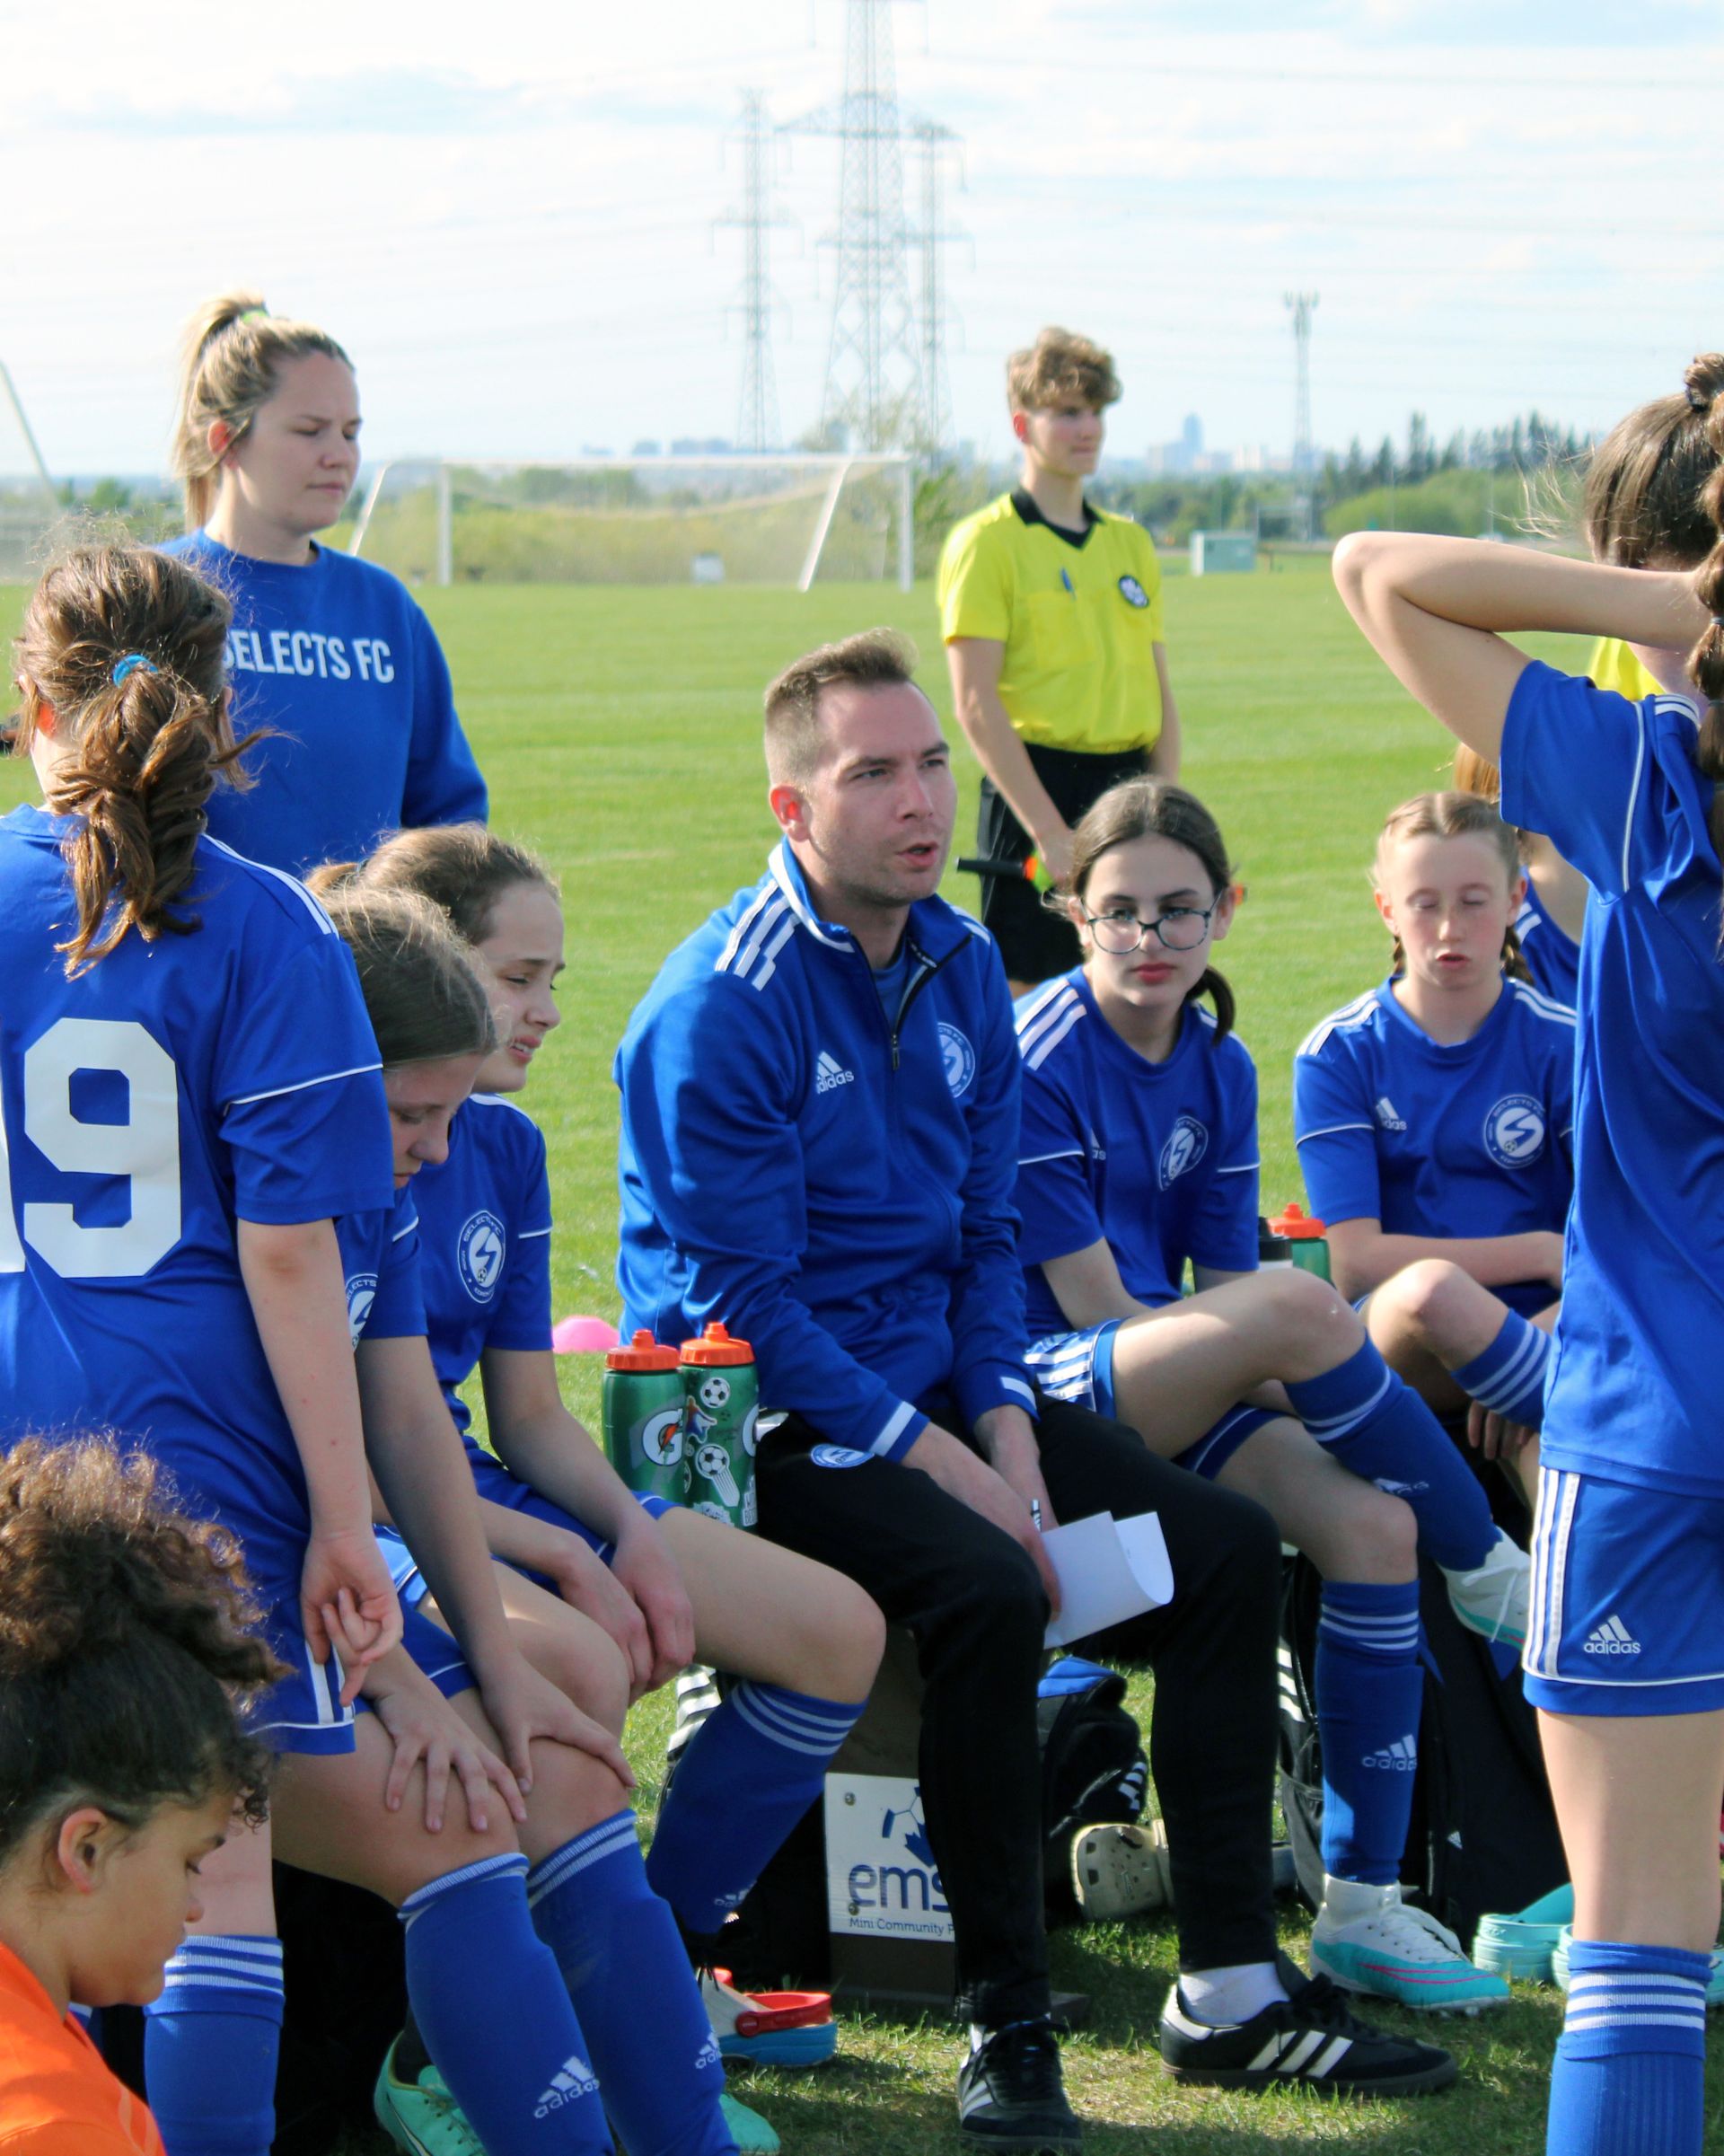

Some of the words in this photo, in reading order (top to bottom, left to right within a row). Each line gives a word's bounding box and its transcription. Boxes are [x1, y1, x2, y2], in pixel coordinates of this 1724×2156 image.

[352, 638, 395, 683] FC
[817, 1070, 855, 1095] didas
[1583, 1639, 1642, 1655] adidas
[849, 1917, 875, 1929] Mini
[876, 1918, 945, 1937] Community
[533, 2077, 601, 2119] adidas
